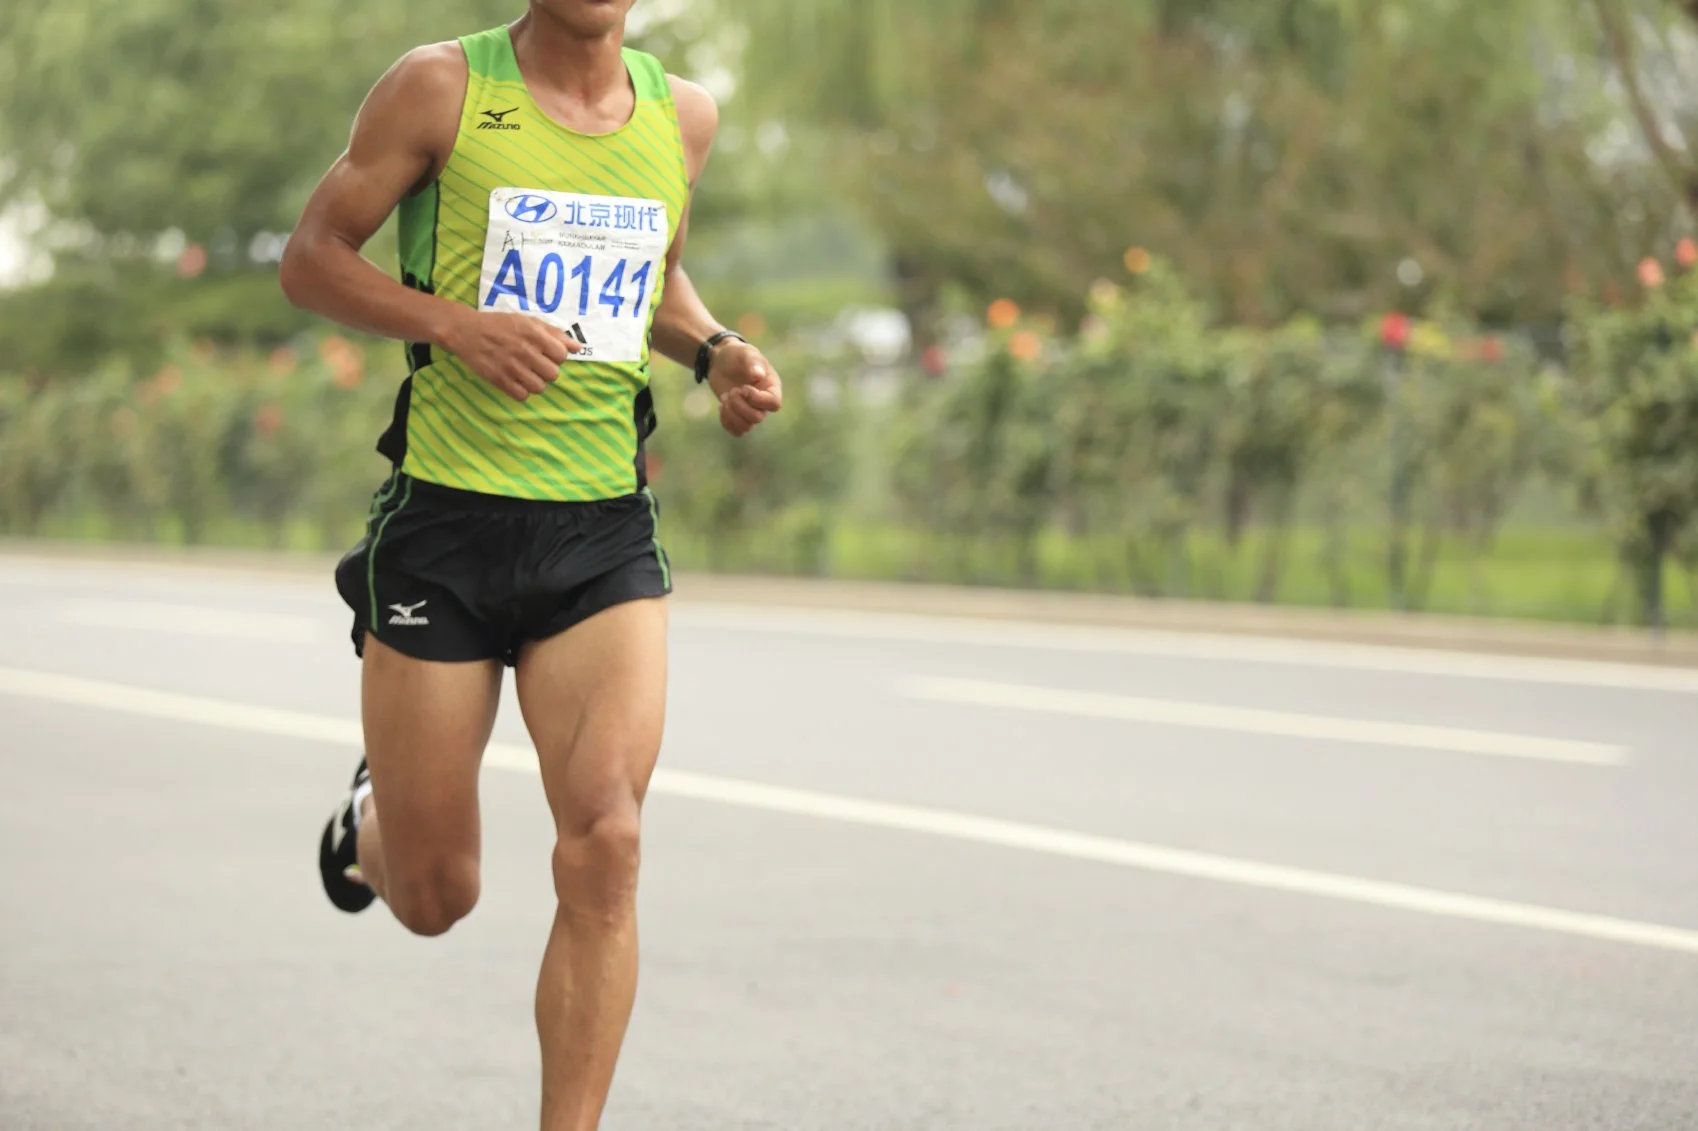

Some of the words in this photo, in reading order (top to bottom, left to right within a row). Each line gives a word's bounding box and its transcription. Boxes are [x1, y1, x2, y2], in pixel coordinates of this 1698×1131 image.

[564, 201, 658, 232] 北京现代
[484, 249, 652, 317] A0141
